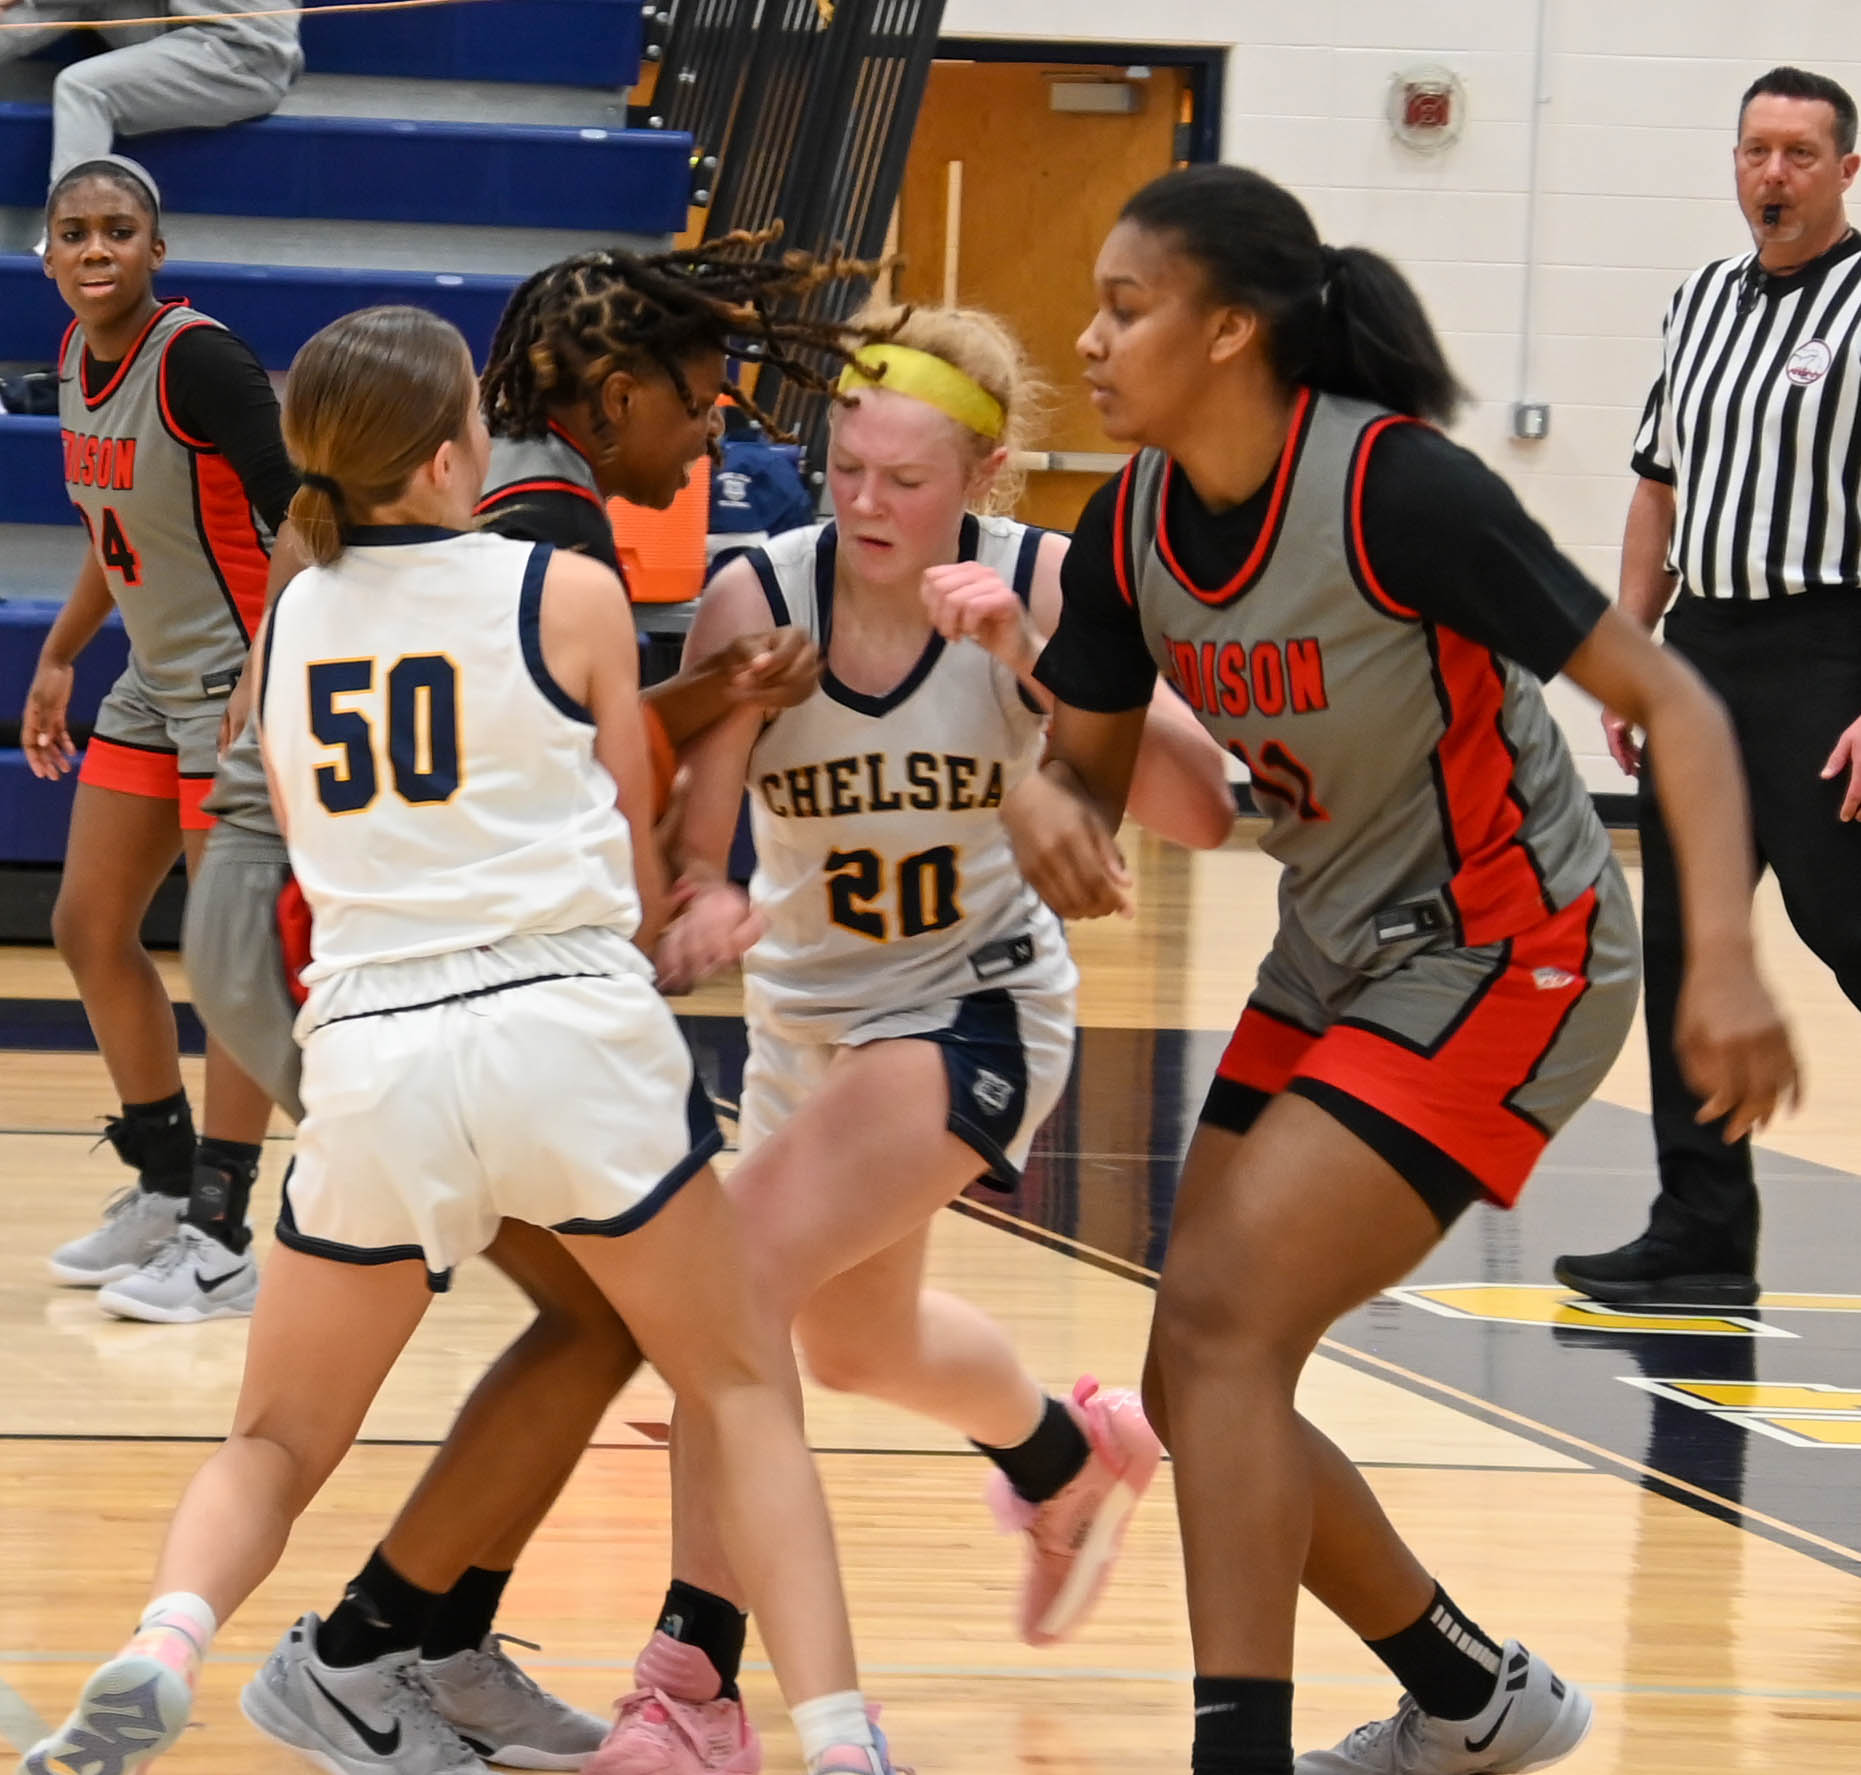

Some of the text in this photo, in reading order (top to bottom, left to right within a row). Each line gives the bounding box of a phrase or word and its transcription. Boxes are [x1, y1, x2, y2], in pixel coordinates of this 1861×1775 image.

[74, 501, 143, 586] 4
[1162, 632, 1329, 718] DISON
[305, 652, 468, 817] 50
[760, 751, 1004, 818] CHELSEA
[824, 845, 966, 944] 20
